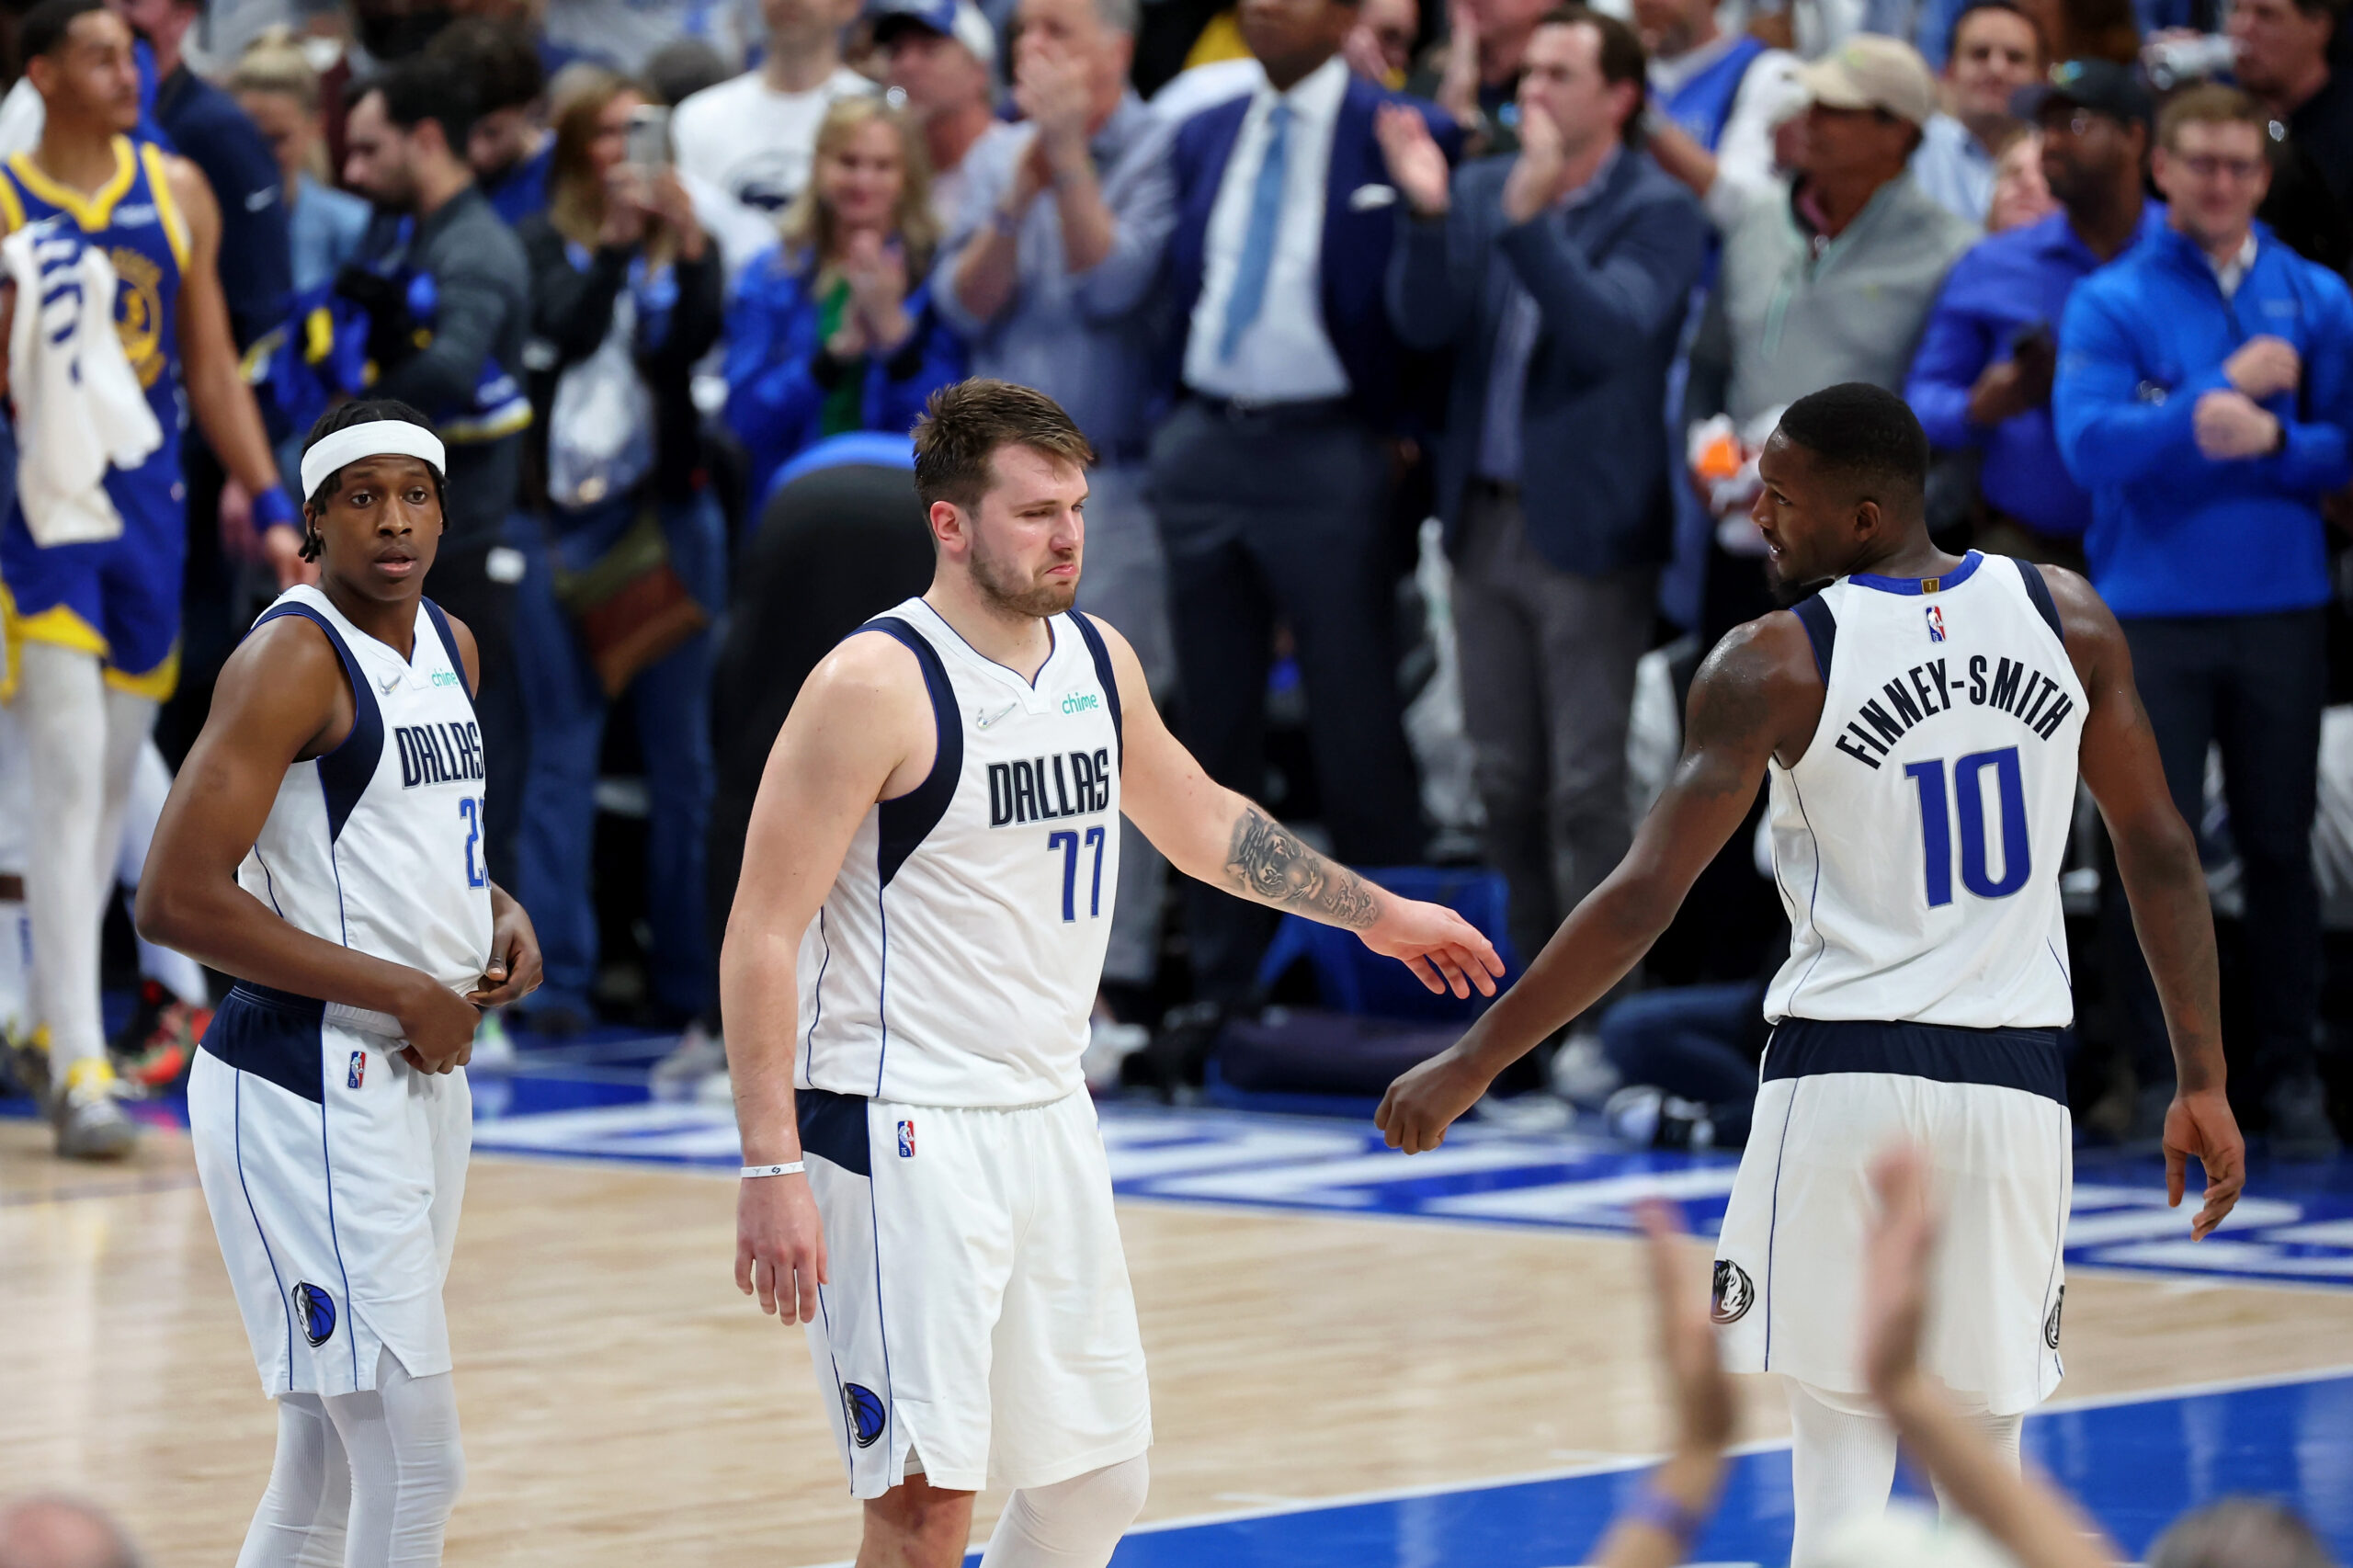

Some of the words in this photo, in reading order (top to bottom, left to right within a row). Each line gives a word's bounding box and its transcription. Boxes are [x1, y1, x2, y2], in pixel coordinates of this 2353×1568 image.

[1062, 691, 1098, 715] chime
[1835, 654, 2074, 770] FINNEY-SMITH
[392, 720, 485, 790] DALLAS
[986, 747, 1110, 828] DALLAS
[1903, 744, 2032, 910] 10
[1047, 824, 1106, 923] 77
